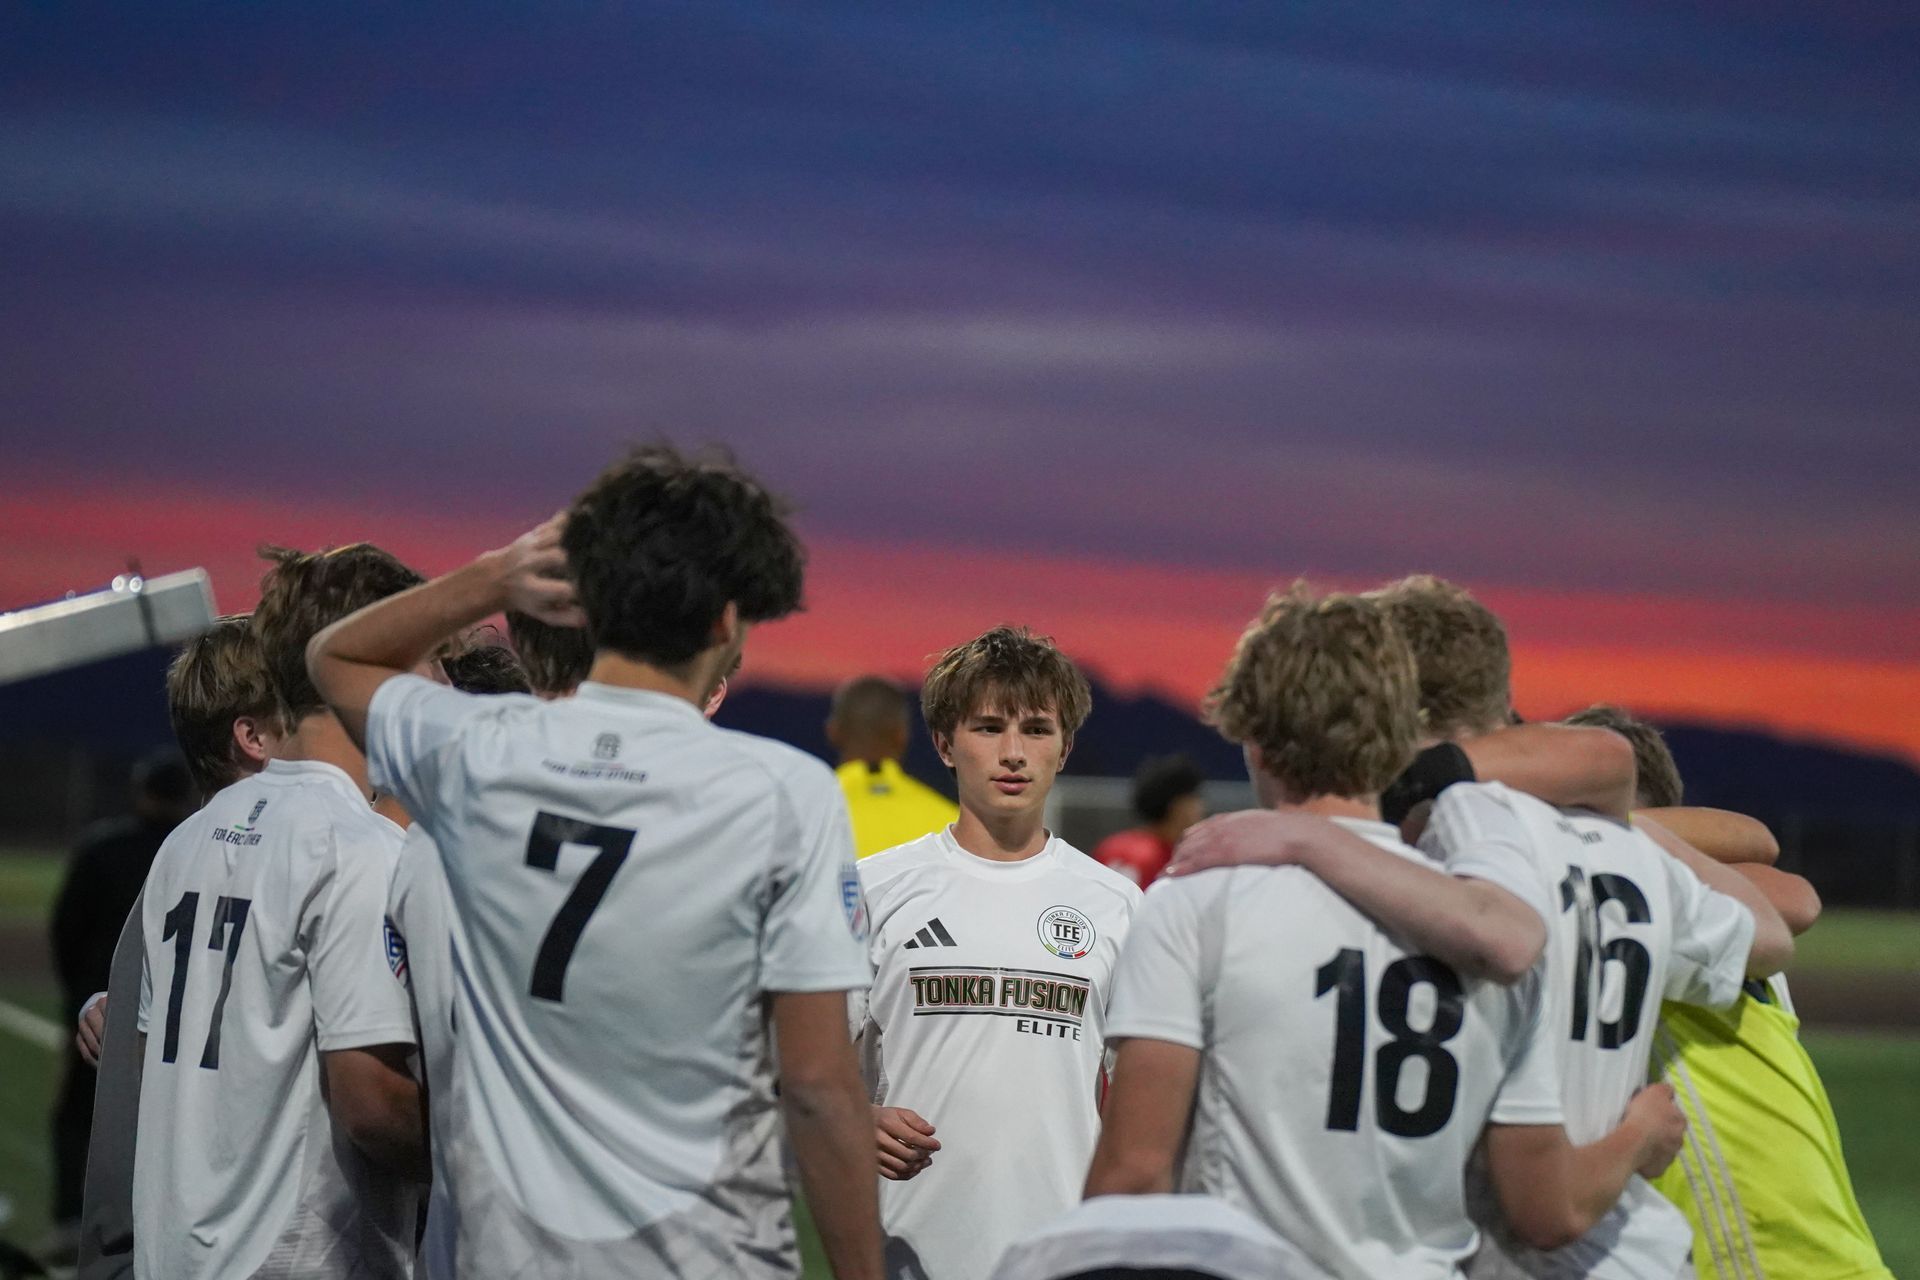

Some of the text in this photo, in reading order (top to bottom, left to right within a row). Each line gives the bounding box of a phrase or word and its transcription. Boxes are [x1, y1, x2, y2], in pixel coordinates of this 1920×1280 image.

[162, 891, 252, 1070] 17
[524, 810, 637, 1002] 7
[1053, 923, 1080, 940] TFE
[1559, 865, 1652, 1049] 16
[910, 975, 1089, 1017] TONKA FUSION
[1016, 1019, 1081, 1042] ELITE
[1314, 948, 1464, 1137] 18
